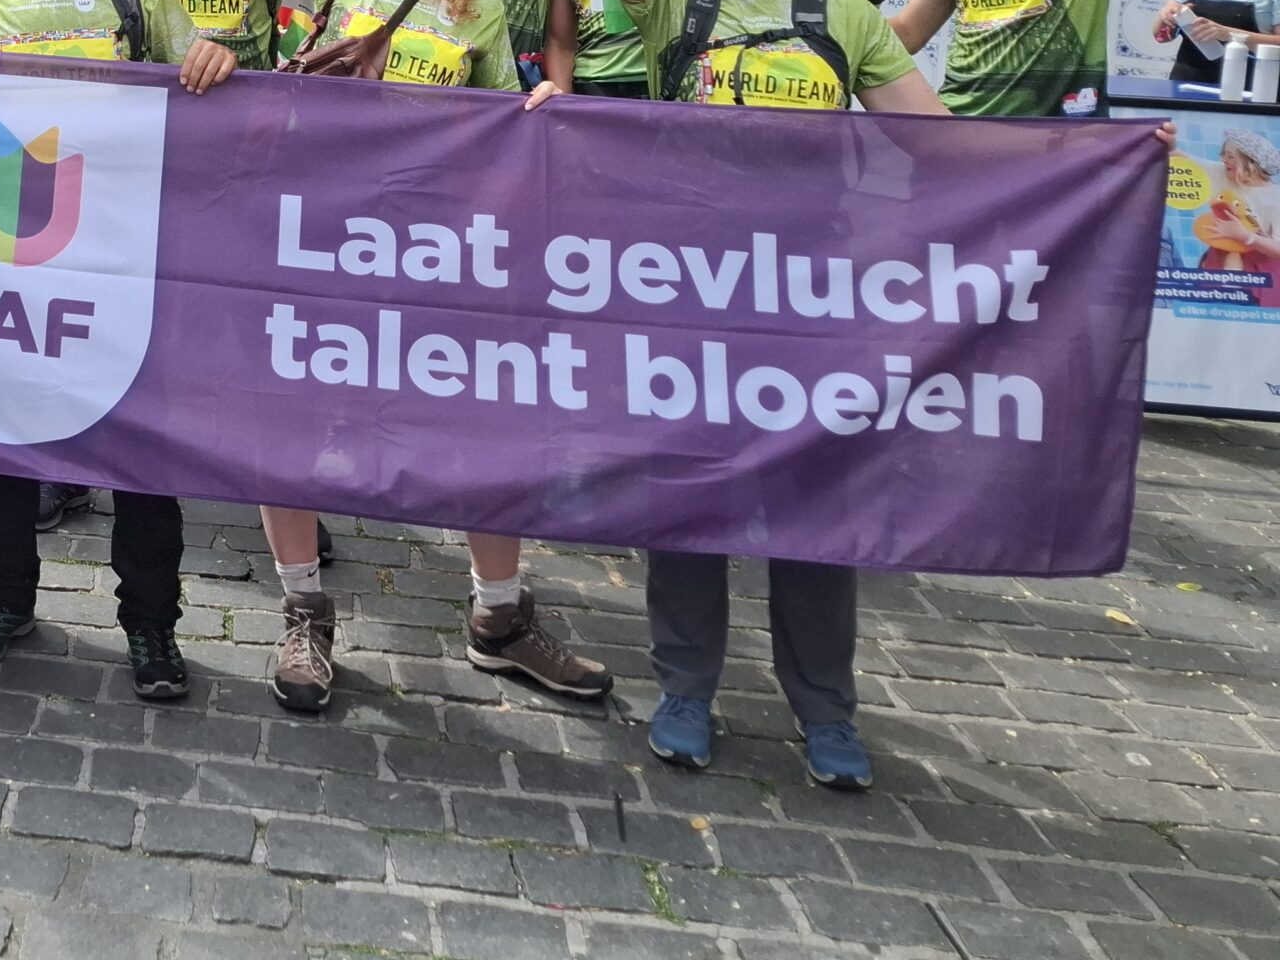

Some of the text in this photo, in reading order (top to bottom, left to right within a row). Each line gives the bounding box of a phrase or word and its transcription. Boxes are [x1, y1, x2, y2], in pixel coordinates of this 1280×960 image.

[724, 34, 748, 47] deuter
[409, 55, 455, 86] TEAM
[711, 69, 836, 105] WORLD TEAM
[1168, 179, 1202, 189] ratis
[1166, 190, 1200, 201] mee!
[277, 194, 1049, 324] Laat gevlucht
[1156, 270, 1267, 285] el doucheplezier
[1154, 288, 1249, 302] waterverbruik
[1179, 305, 1207, 316] elke
[1210, 307, 1260, 320] druppel
[265, 303, 1044, 442] talent bloeien
